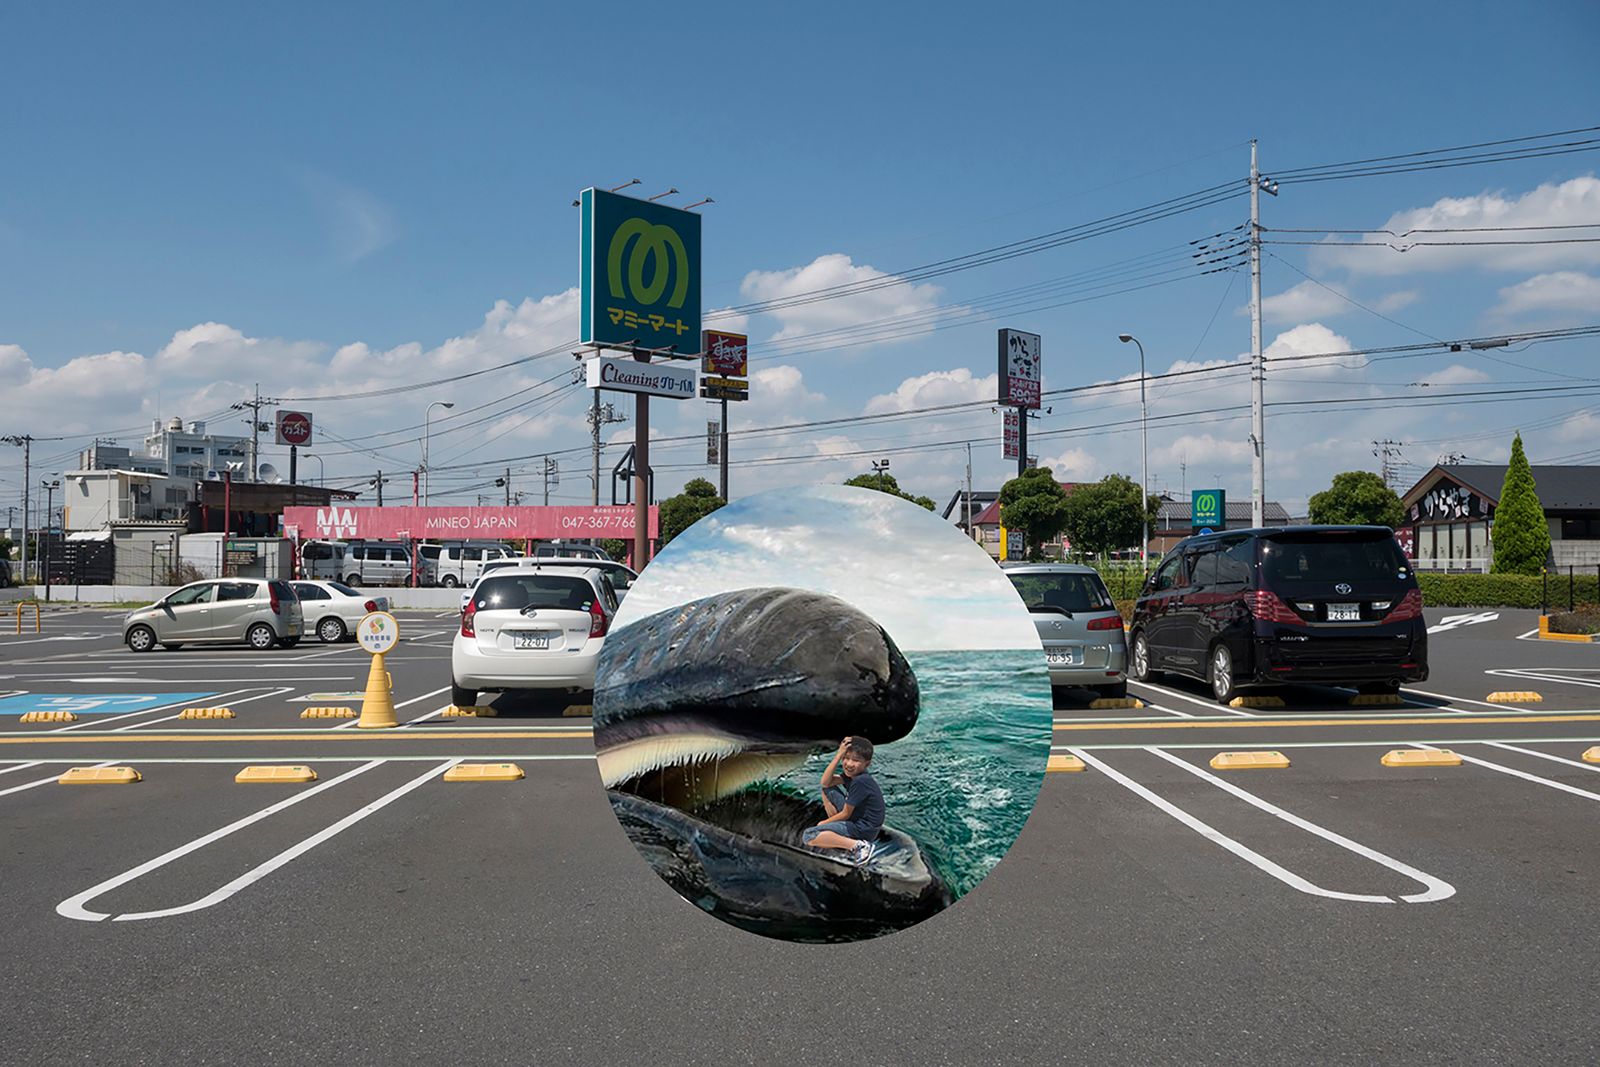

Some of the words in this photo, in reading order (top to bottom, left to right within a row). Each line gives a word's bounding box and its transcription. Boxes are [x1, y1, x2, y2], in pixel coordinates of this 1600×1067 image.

[607, 307, 689, 335] マミーマート
[601, 363, 660, 389] Cleaning
[660, 376, 695, 393] グローバル
[426, 516, 471, 529] MINEO
[473, 516, 518, 529] JAPAN
[562, 516, 636, 529] 047-367-766
[521, 637, 546, 648] 22-07
